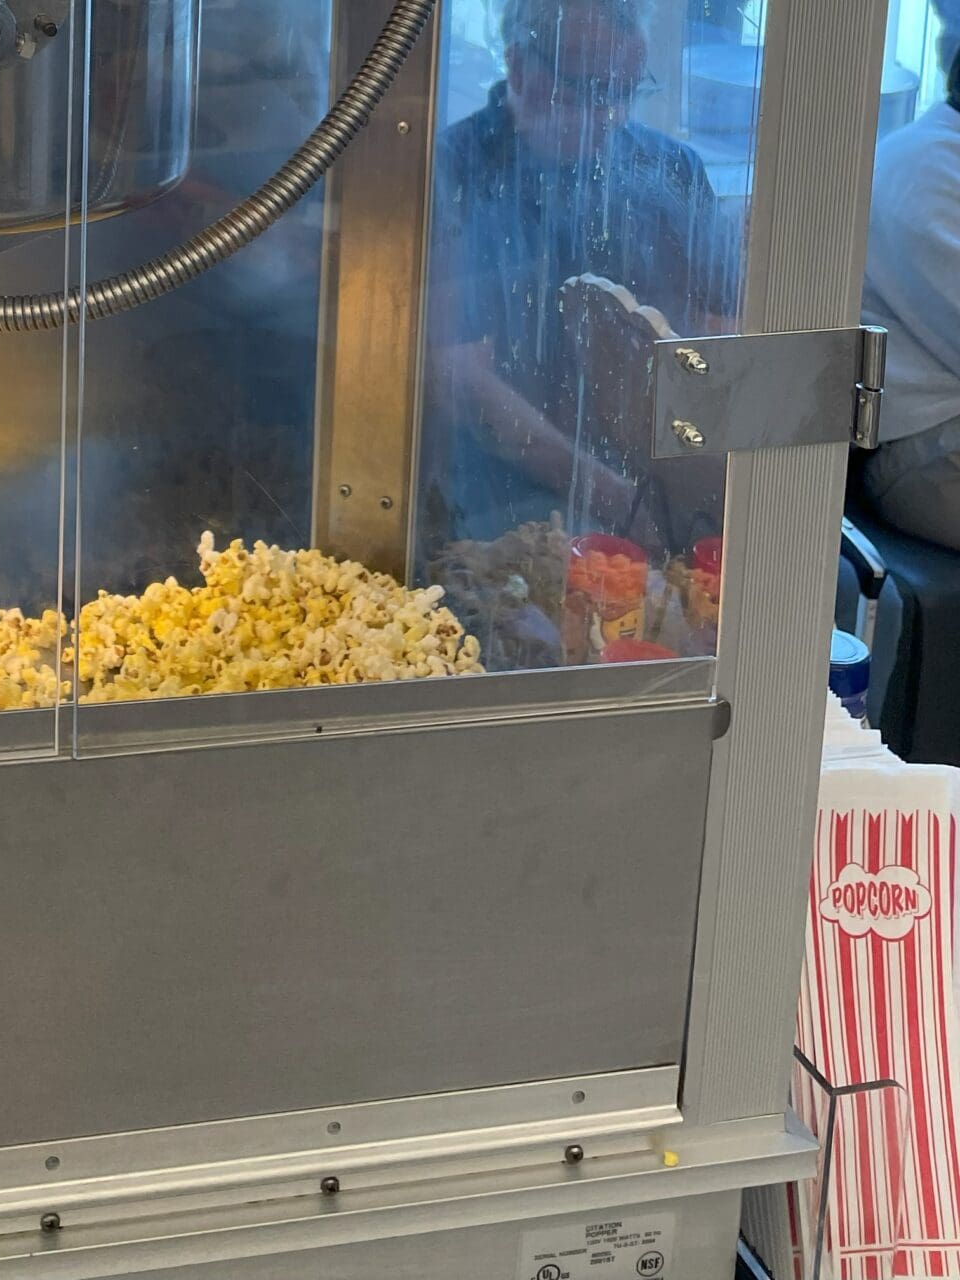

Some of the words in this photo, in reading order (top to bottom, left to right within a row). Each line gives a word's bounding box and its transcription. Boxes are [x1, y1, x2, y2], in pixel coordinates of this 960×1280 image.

[832, 881, 918, 917] POPCORN
[586, 1222, 622, 1232] CITATION
[586, 1229, 617, 1238] POPPER
[641, 1258, 660, 1270] NSF
[542, 1270, 553, 1279] UL
